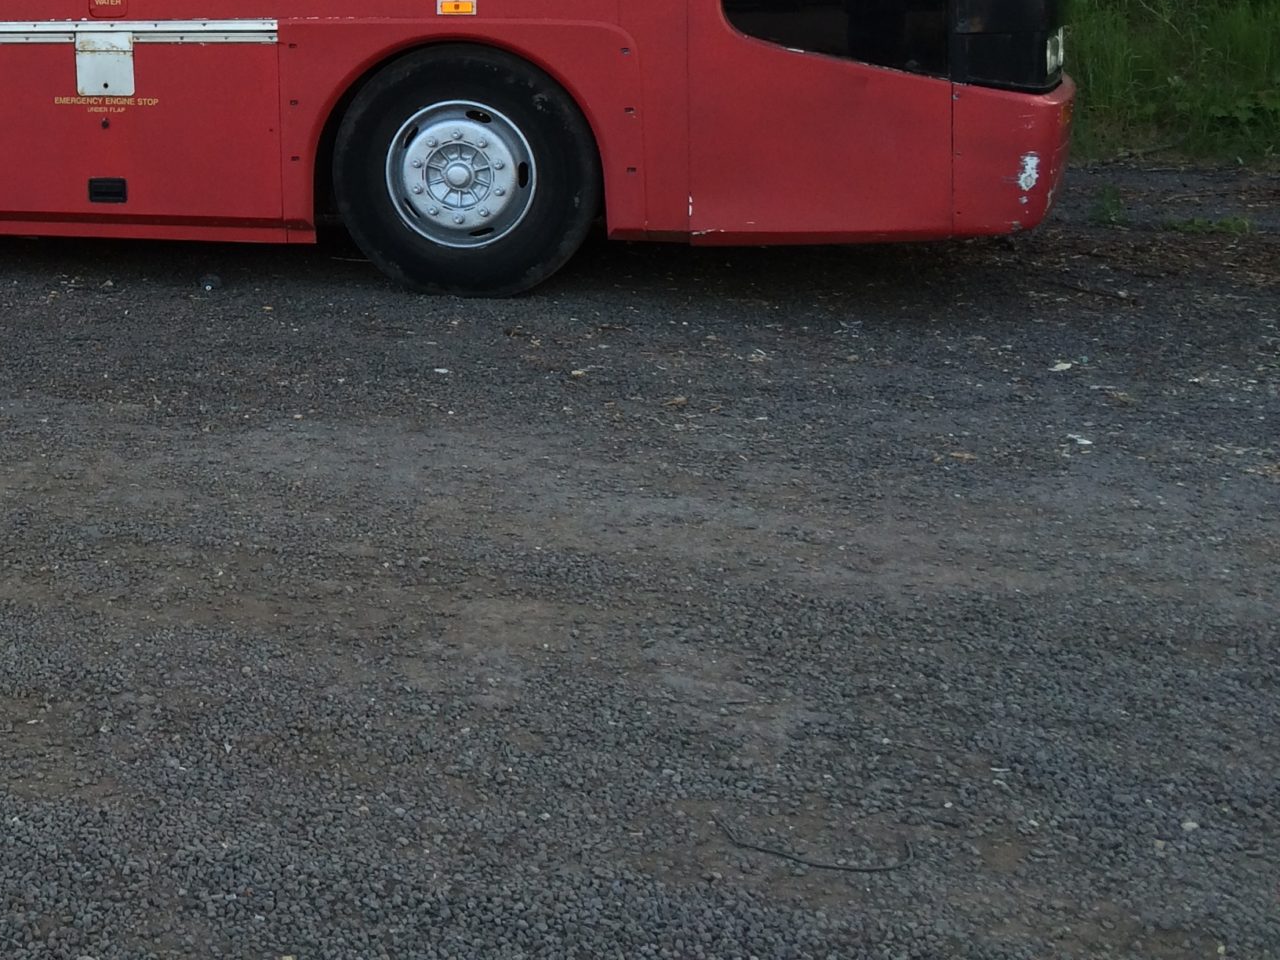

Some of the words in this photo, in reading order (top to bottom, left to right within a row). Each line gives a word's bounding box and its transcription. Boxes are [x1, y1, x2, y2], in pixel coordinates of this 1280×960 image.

[54, 96, 103, 105] EMERGENCY
[105, 97, 135, 105] ENGINE
[137, 98, 159, 106] STOP
